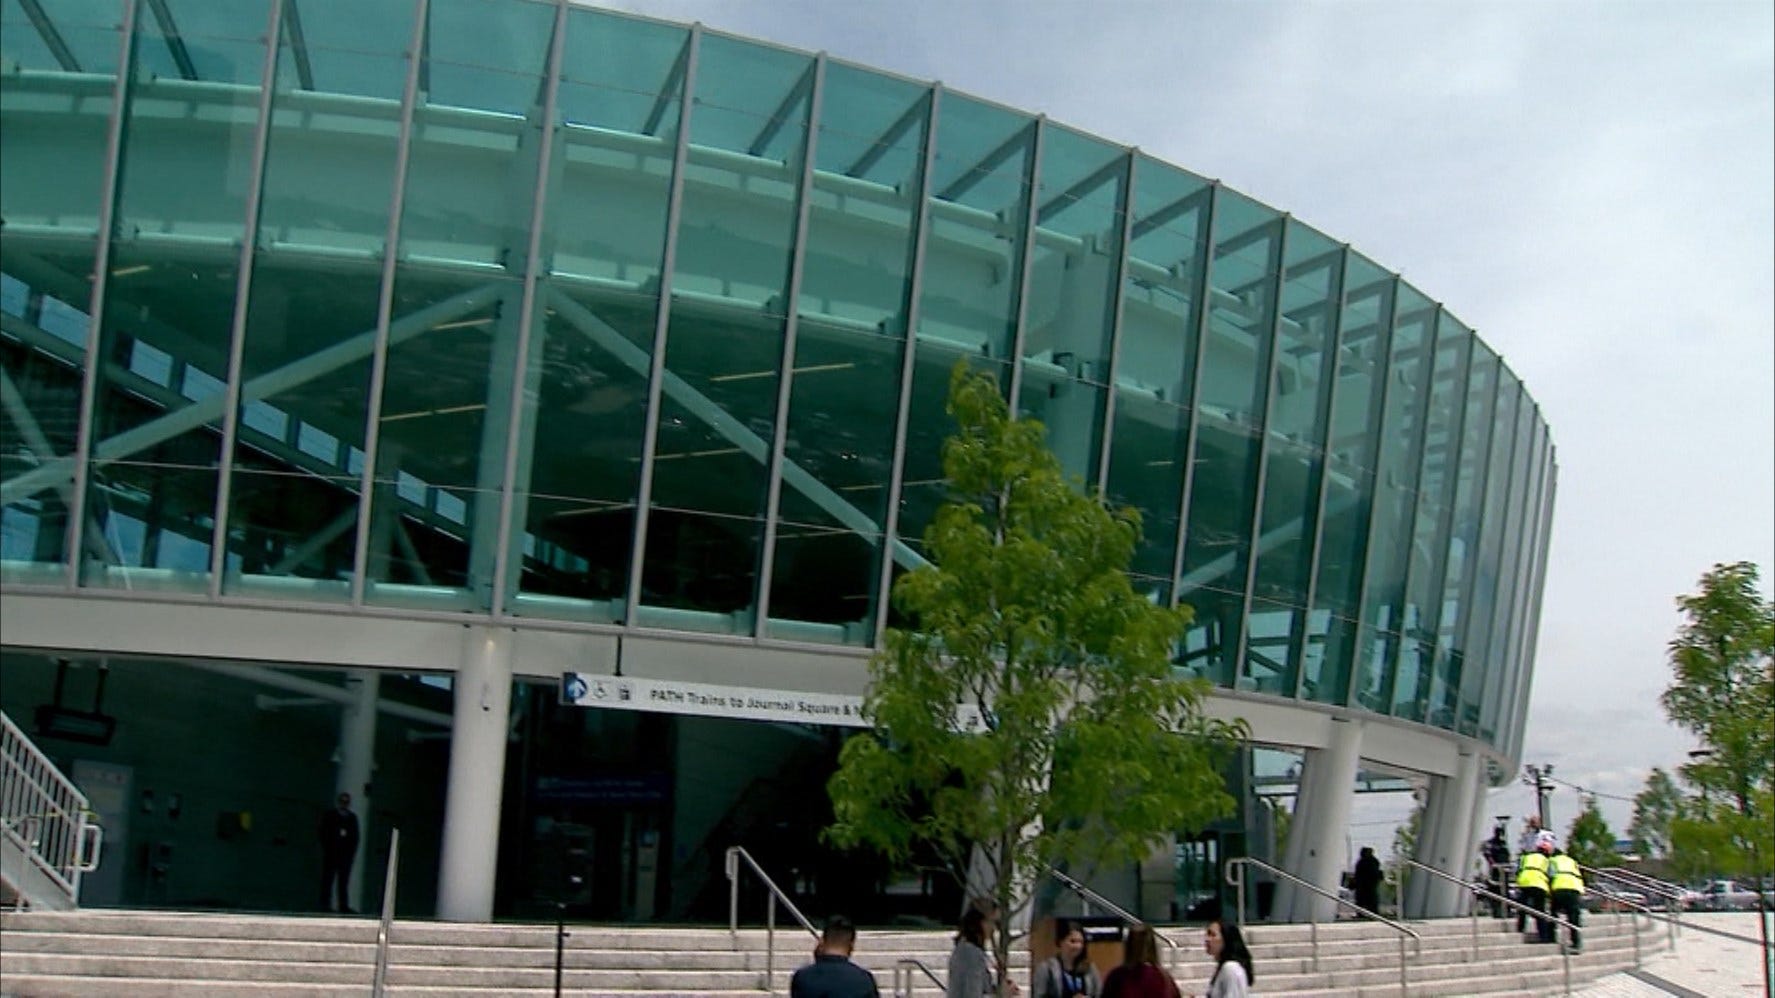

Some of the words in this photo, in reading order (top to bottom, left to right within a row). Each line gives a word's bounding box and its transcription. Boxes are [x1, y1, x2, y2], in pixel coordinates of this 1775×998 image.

[650, 689, 685, 703] PATH
[688, 692, 725, 706] Trains
[730, 697, 744, 708] to
[747, 697, 795, 712] Journal
[797, 701, 840, 716] Square
[843, 704, 851, 716] &
